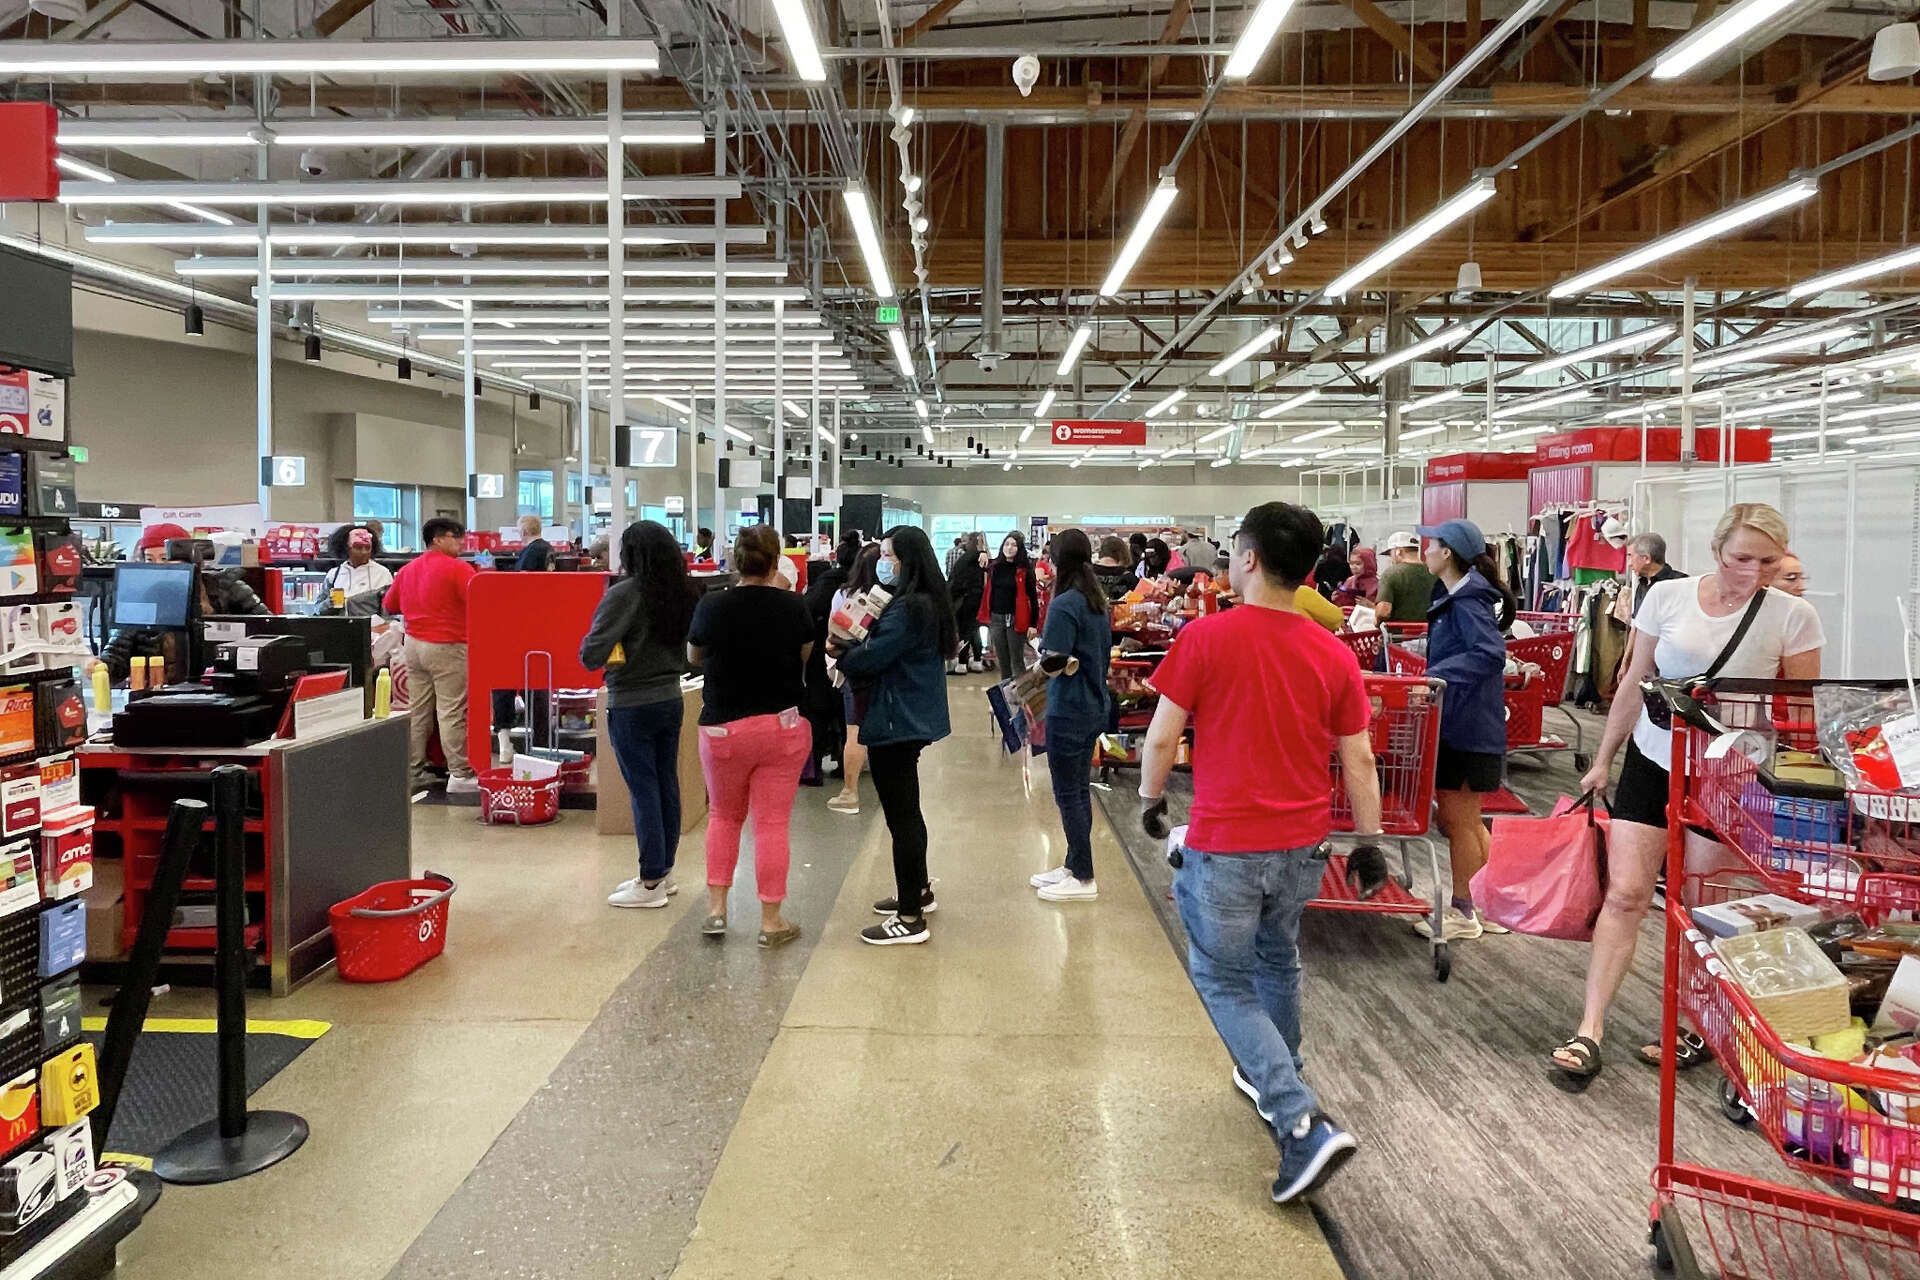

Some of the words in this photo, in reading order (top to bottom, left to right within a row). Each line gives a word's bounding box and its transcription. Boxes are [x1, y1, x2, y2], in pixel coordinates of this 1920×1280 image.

[880, 308, 897, 321] EXIT
[640, 431, 664, 462] 7
[1572, 443, 1593, 454] room
[280, 460, 296, 483] 6
[482, 475, 496, 496] 4
[101, 504, 120, 518] Ice
[65, 1160, 88, 1179] TACO
[67, 1170, 89, 1189] BELL
